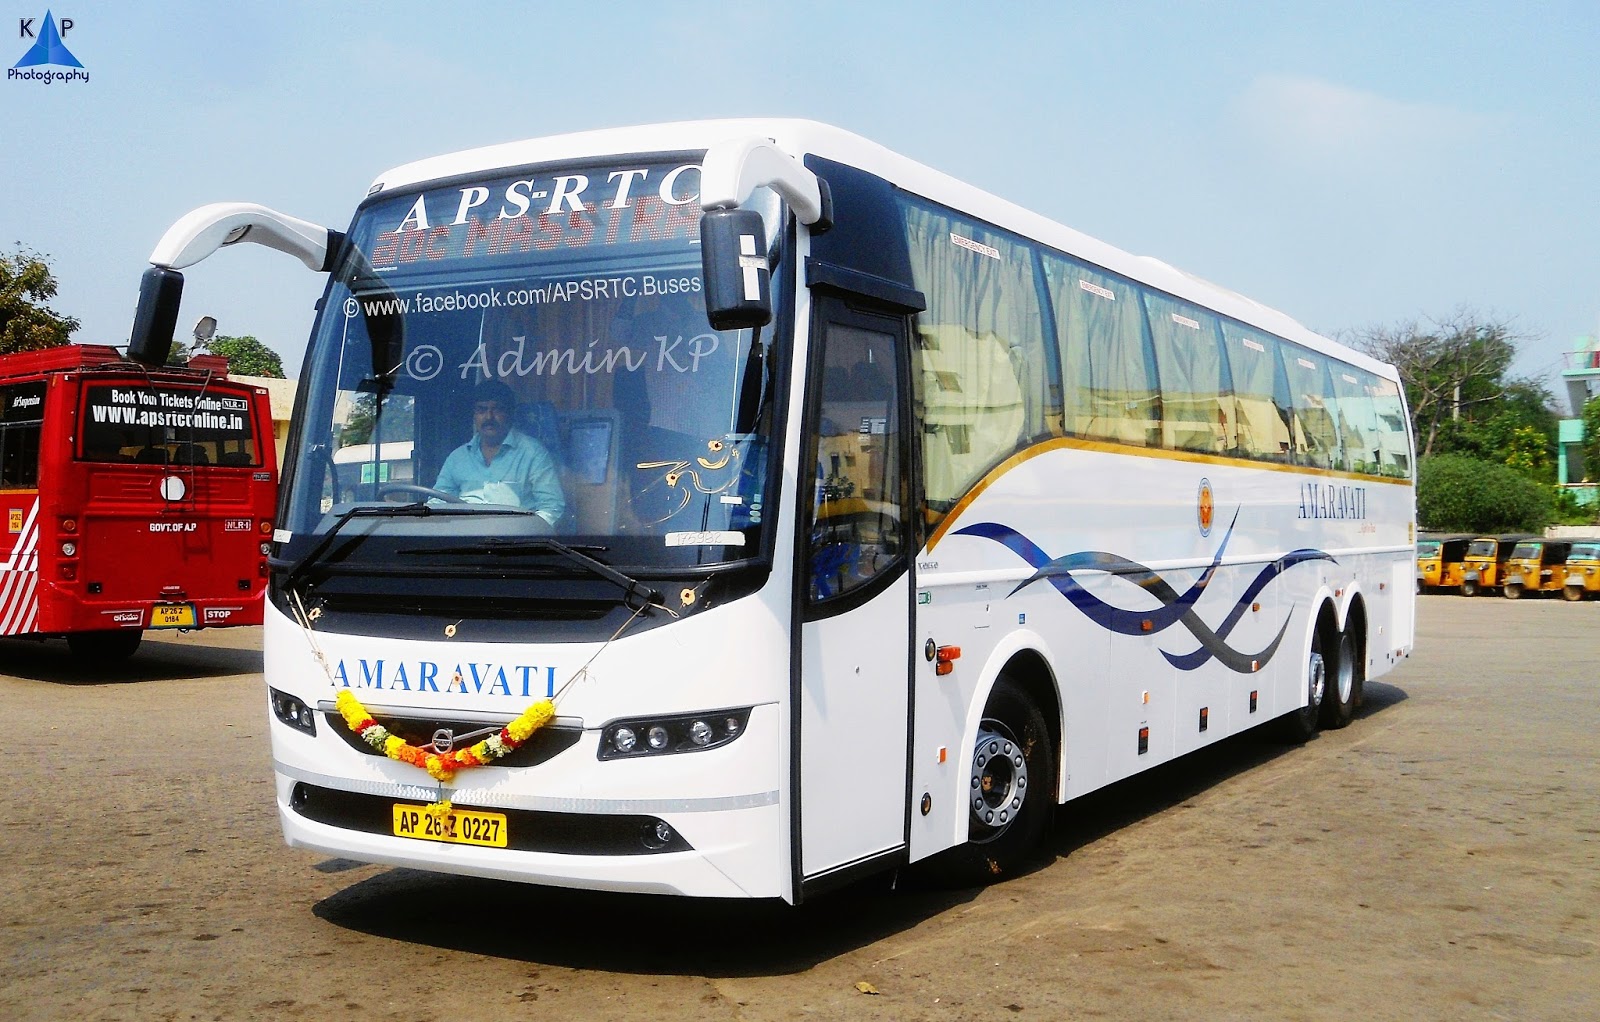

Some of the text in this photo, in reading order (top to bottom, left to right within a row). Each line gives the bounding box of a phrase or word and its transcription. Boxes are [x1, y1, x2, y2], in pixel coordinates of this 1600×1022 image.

[953, 235, 985, 253] EMERGENCY
[112, 389, 136, 404] Book
[159, 393, 193, 409] Tickets
[195, 396, 222, 411] Online
[1298, 482, 1366, 520] AMARAVATI
[161, 607, 169, 615] AP
[170, 607, 178, 615] 26
[207, 610, 231, 619] STOP
[329, 658, 558, 698] AMARAVATI
[400, 811, 500, 842] AP 26 Z 0227
